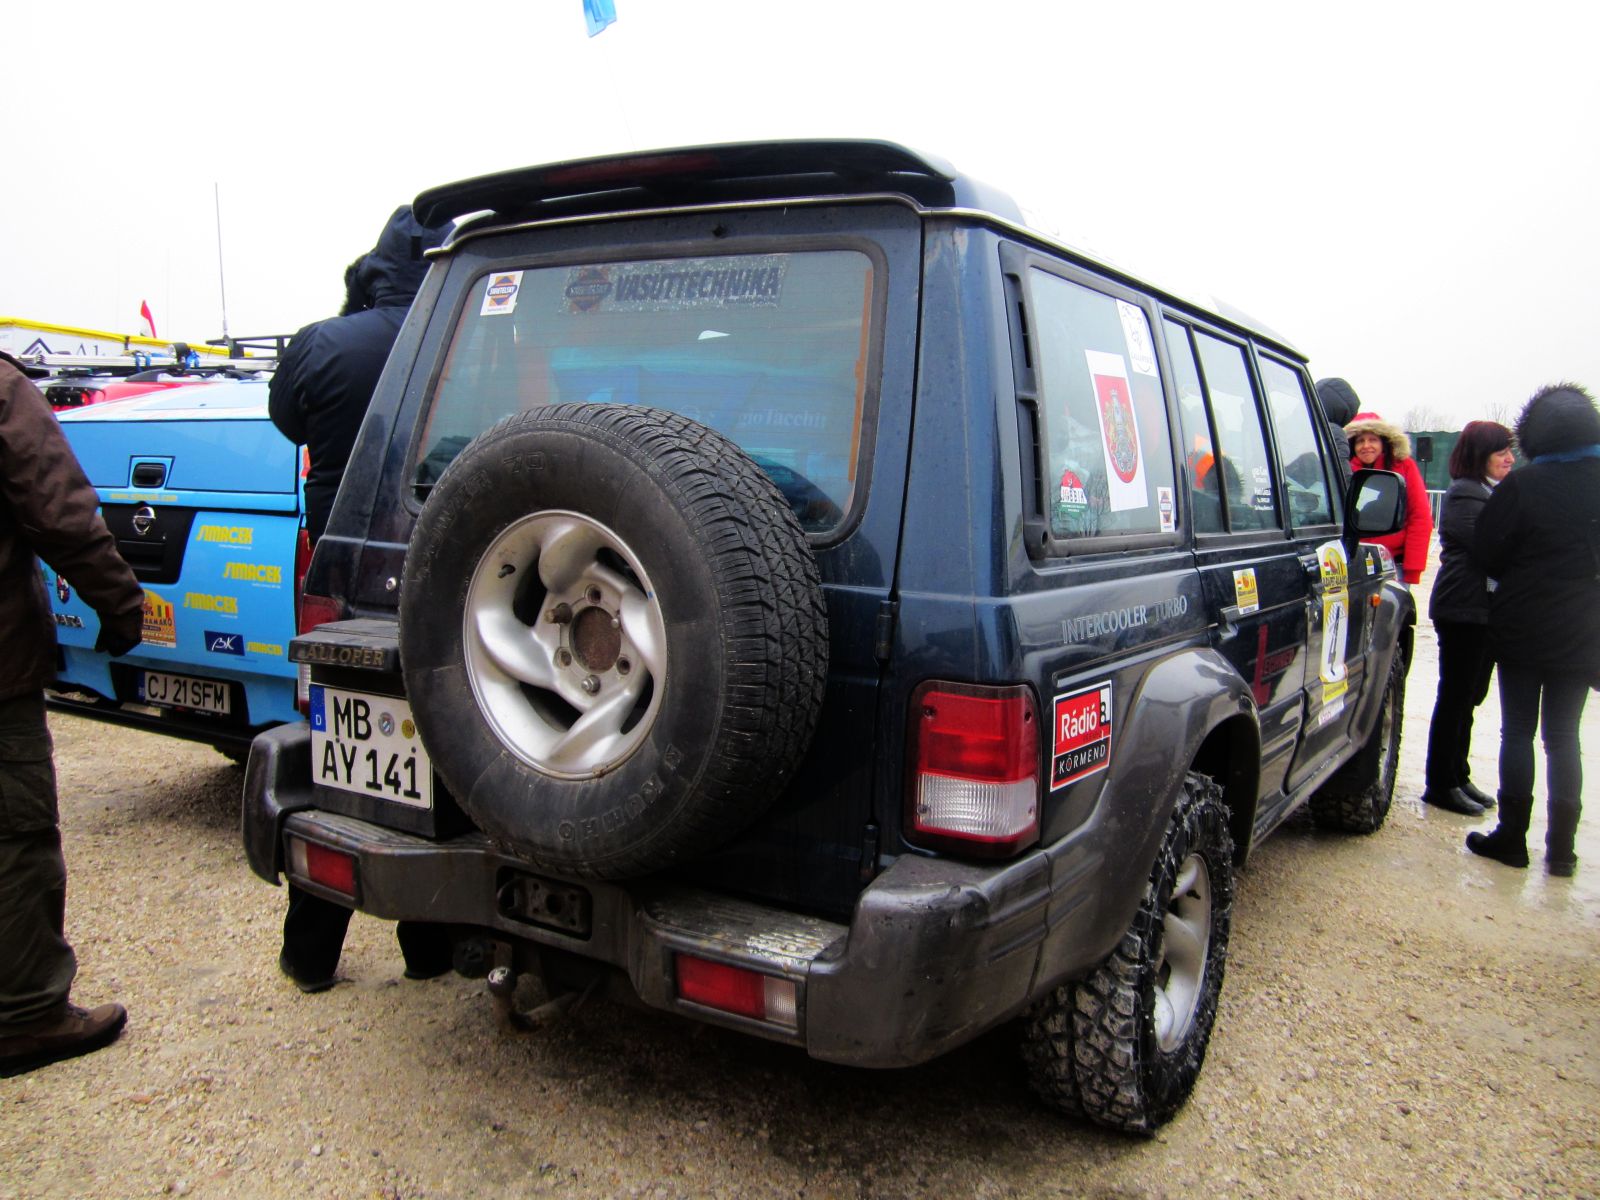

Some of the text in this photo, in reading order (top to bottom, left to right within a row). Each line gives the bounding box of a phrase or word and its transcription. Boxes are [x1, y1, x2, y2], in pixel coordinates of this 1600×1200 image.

[1061, 594, 1189, 645] INTERCOOLER TURBO
[148, 675, 168, 700] CJ
[172, 678, 188, 704] 21
[191, 681, 226, 711] SFM
[314, 714, 322, 726] D
[333, 696, 373, 741] MB
[1061, 703, 1098, 742] Rádió
[321, 739, 422, 800] AY 141
[1058, 744, 1107, 775] KÖRMEND
